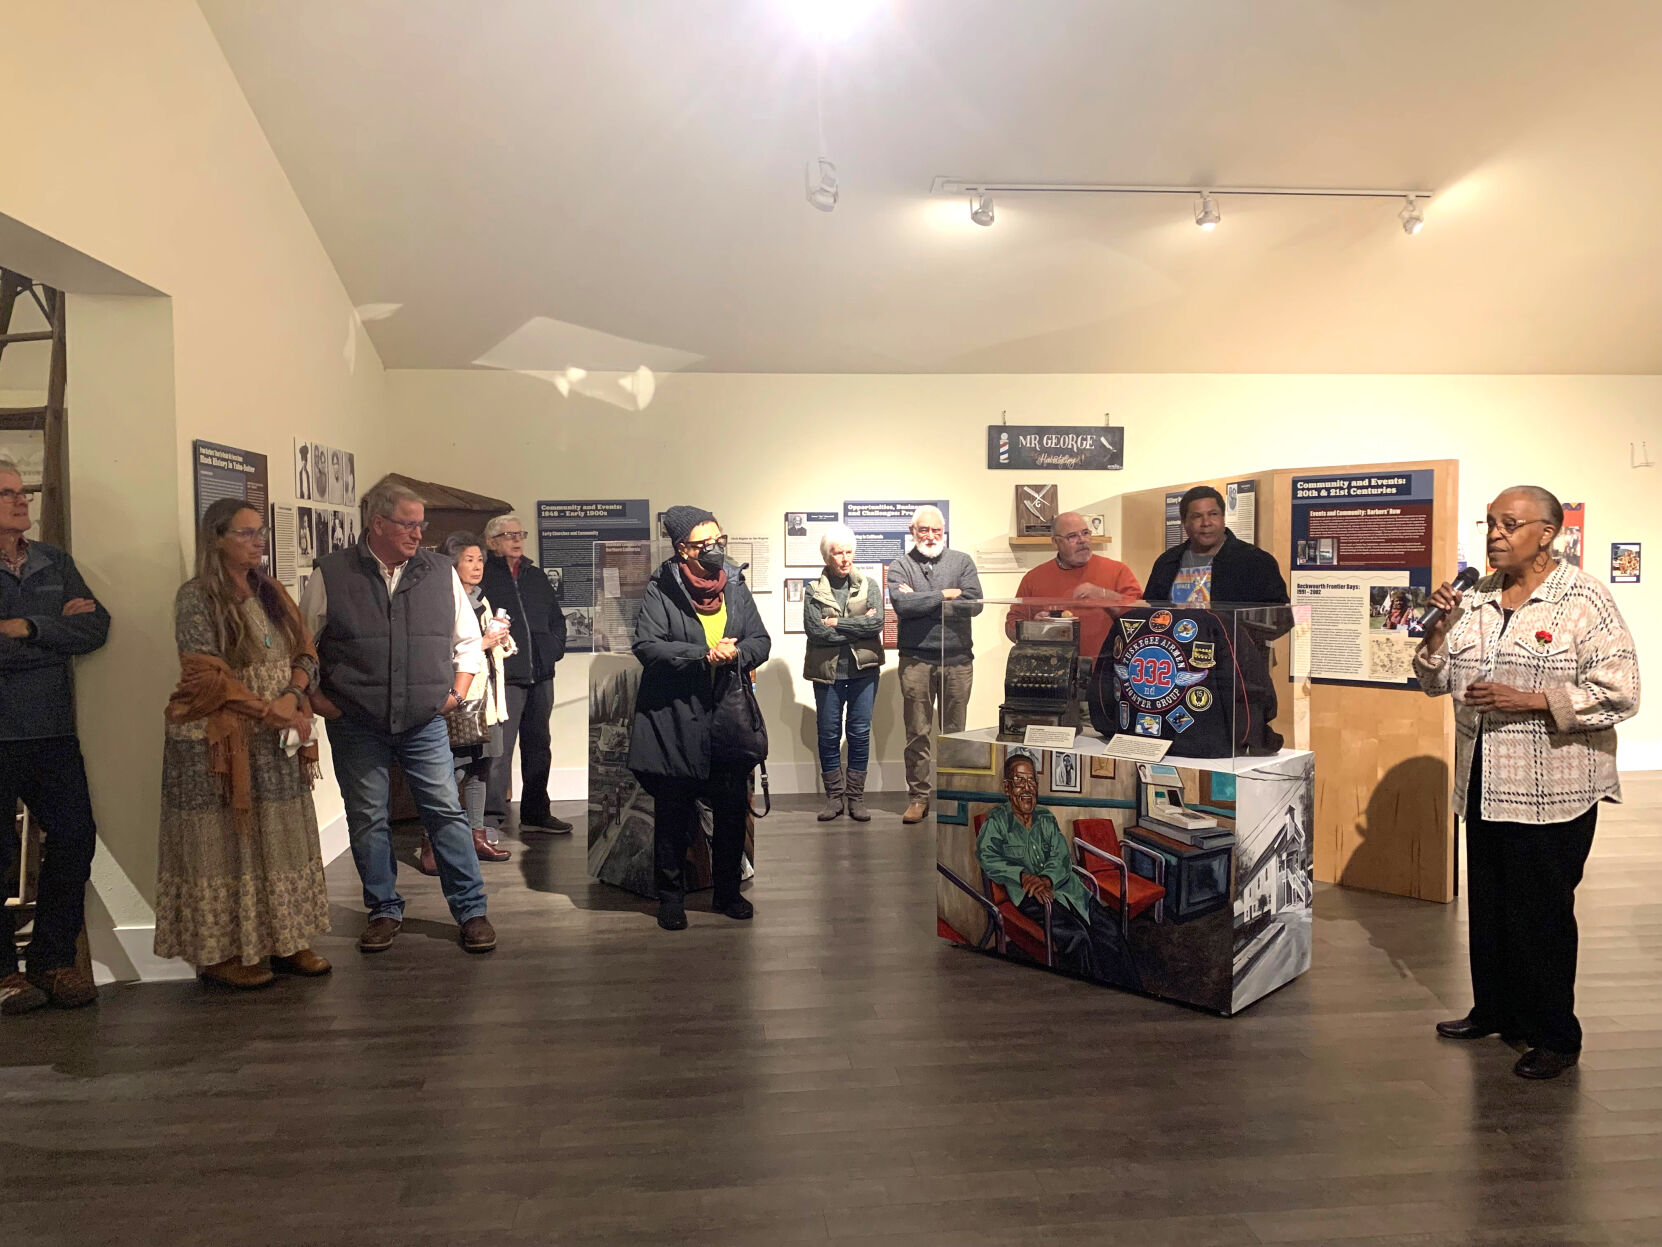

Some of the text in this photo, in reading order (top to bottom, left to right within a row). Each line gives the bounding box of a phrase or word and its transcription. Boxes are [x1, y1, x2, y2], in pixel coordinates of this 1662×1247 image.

[1019, 434, 1096, 452] MR GEORGE
[213, 458, 227, 469] History
[1297, 477, 1406, 489] Community and Events:
[1297, 486, 1397, 498] 20th & 21st Centuries
[848, 504, 895, 512] Opportunities,
[1327, 509, 1336, 517] and
[1336, 509, 1367, 518] Community:
[1123, 637, 1186, 668] TUSKEGEE AIRMEN
[1131, 657, 1172, 687] 332
[1124, 682, 1180, 708] FIGHTER GROUP
[1144, 687, 1155, 695] nd
